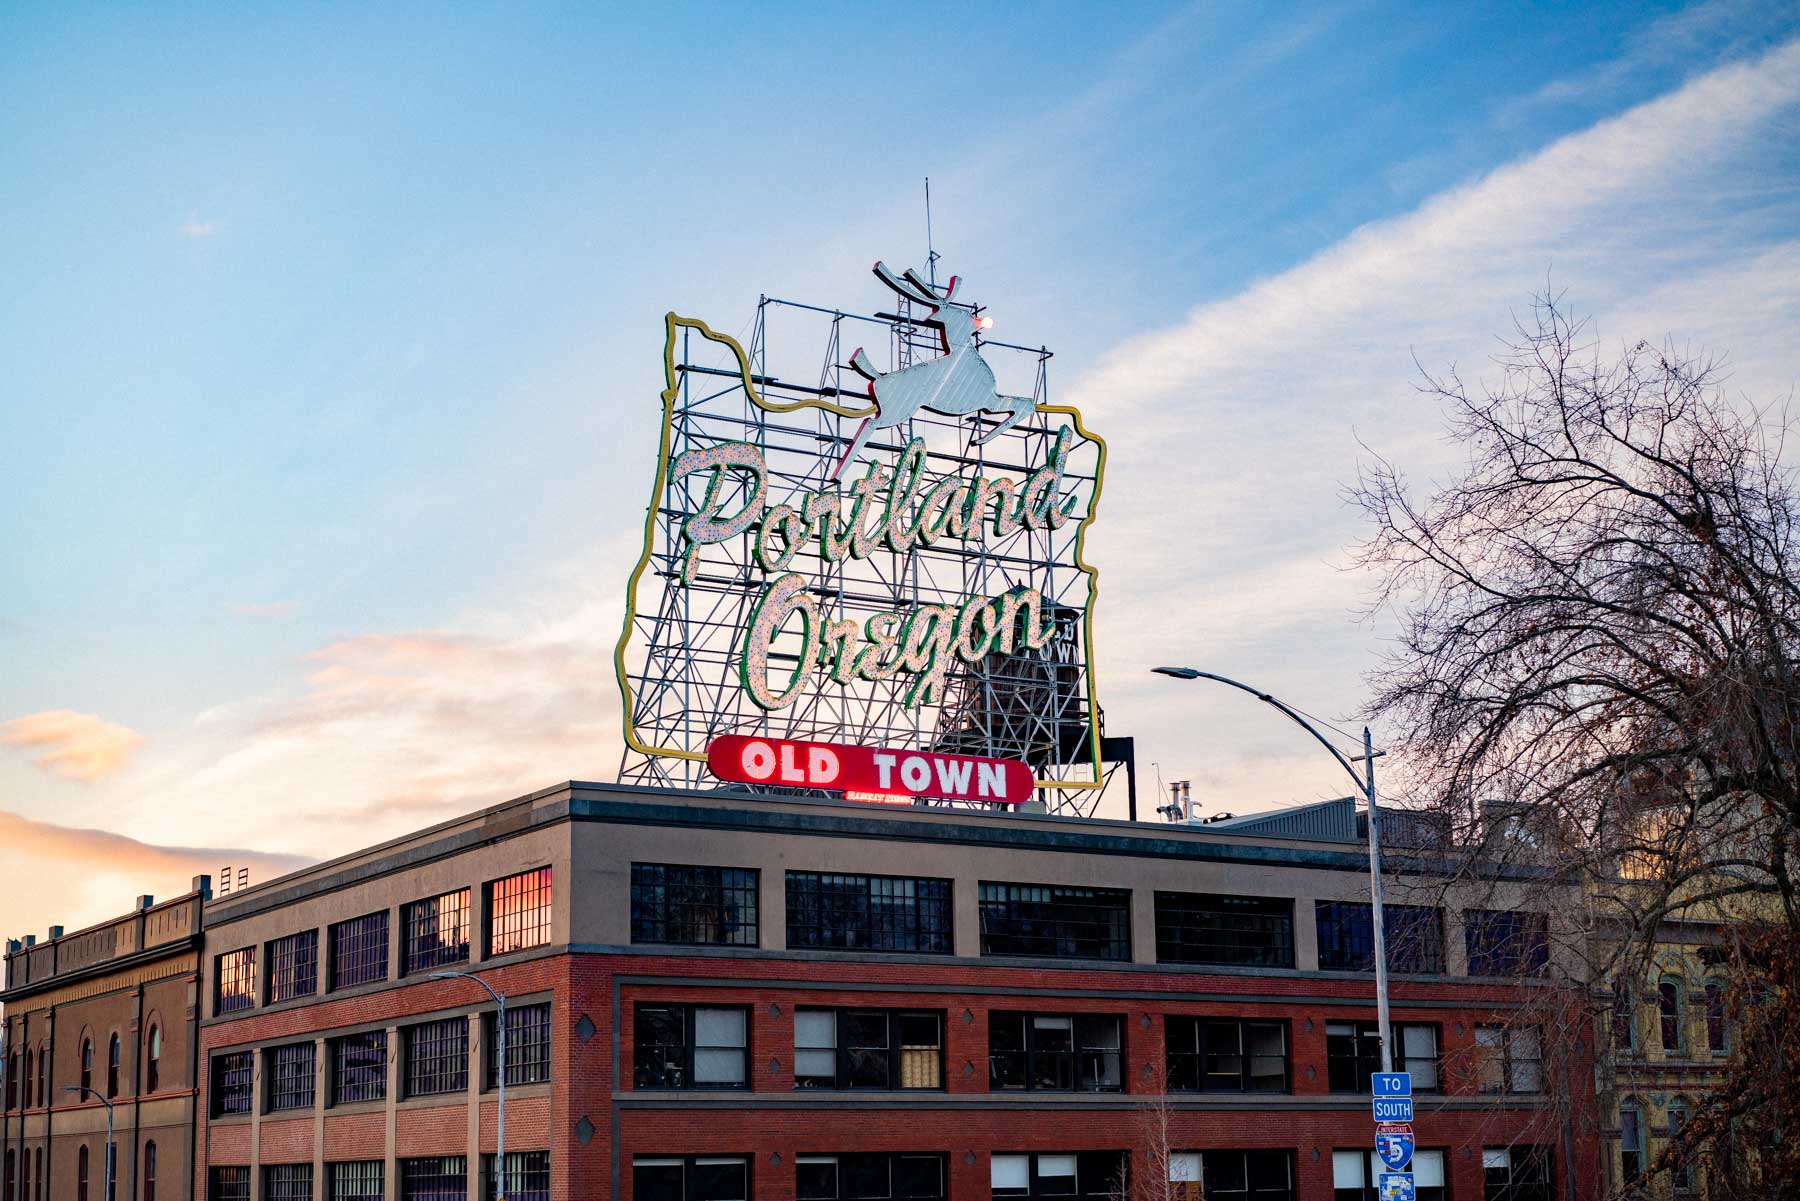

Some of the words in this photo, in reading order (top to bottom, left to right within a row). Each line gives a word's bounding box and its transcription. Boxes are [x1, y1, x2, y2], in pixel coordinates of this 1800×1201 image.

[670, 424, 1077, 586] Portland
[740, 572, 1057, 710] Oregon
[741, 741, 839, 784] OLD
[873, 753, 1007, 798] TOWN
[1382, 1078, 1401, 1091] TO
[1376, 1103, 1411, 1117] SOUTH
[1389, 1137, 1404, 1163] 5
